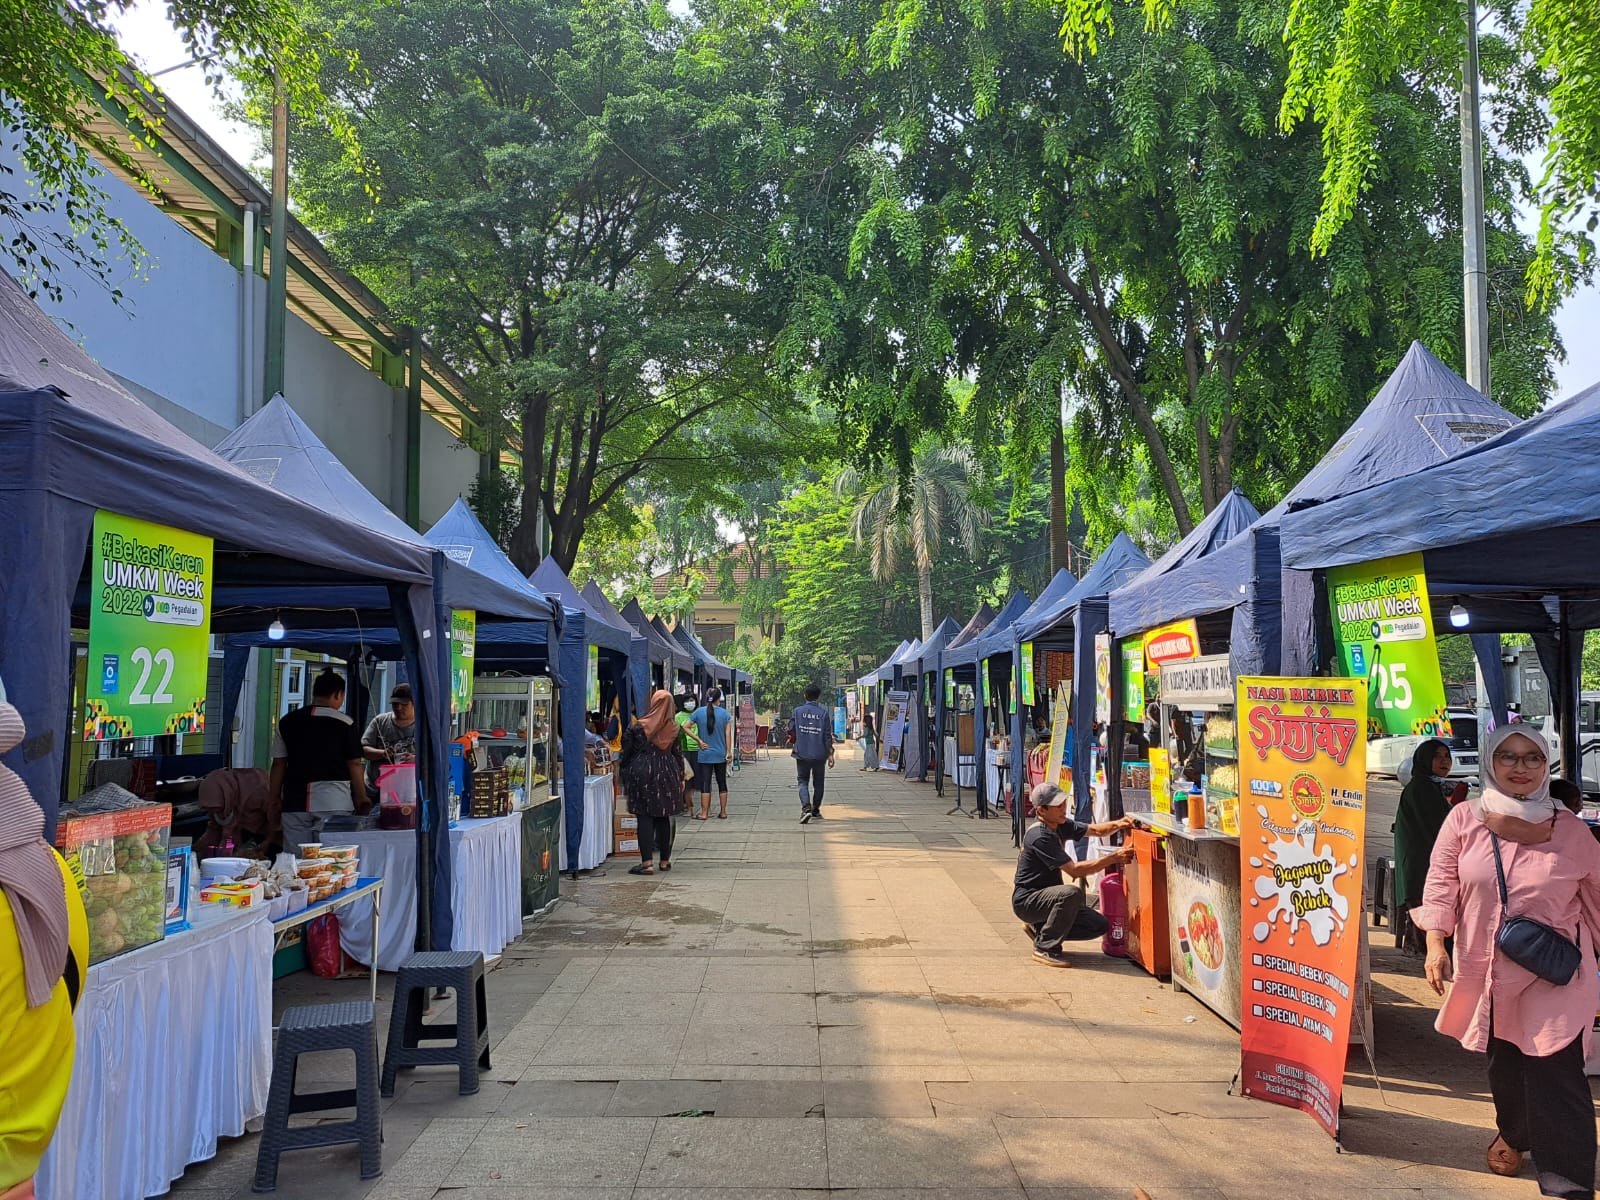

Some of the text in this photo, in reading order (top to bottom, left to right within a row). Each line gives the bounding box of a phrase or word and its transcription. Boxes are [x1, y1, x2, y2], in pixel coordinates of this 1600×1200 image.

[102, 532, 204, 574] #BekasiKeren
[103, 559, 205, 599] UMKM Week
[1334, 575, 1418, 603] #BekasiKeren
[101, 586, 198, 616] 2022 by Pegadaian
[1337, 593, 1423, 623] UMKM Week
[1340, 620, 1372, 643] 2022
[1394, 621, 1420, 634] Pegadaian
[129, 646, 175, 705] 22
[458, 668, 468, 697] 20
[1184, 668, 1209, 692] BANDUNG
[1371, 663, 1413, 710] 25
[1128, 683, 1138, 709] 23
[1247, 686, 1355, 704] NASI BEBEK
[1248, 703, 1357, 765] Sinjay
[1342, 789, 1363, 801] Endin
[1273, 859, 1332, 888] Jagonya
[1290, 887, 1332, 917] Bebek
[1265, 955, 1299, 977] SPECIAL
[1299, 963, 1324, 984] BEBEK
[1265, 981, 1300, 1002] SPECIAL
[1301, 990, 1325, 1010] BEBEK
[1265, 1006, 1301, 1028] SPECIAL
[1302, 1016, 1321, 1036] AYAM
